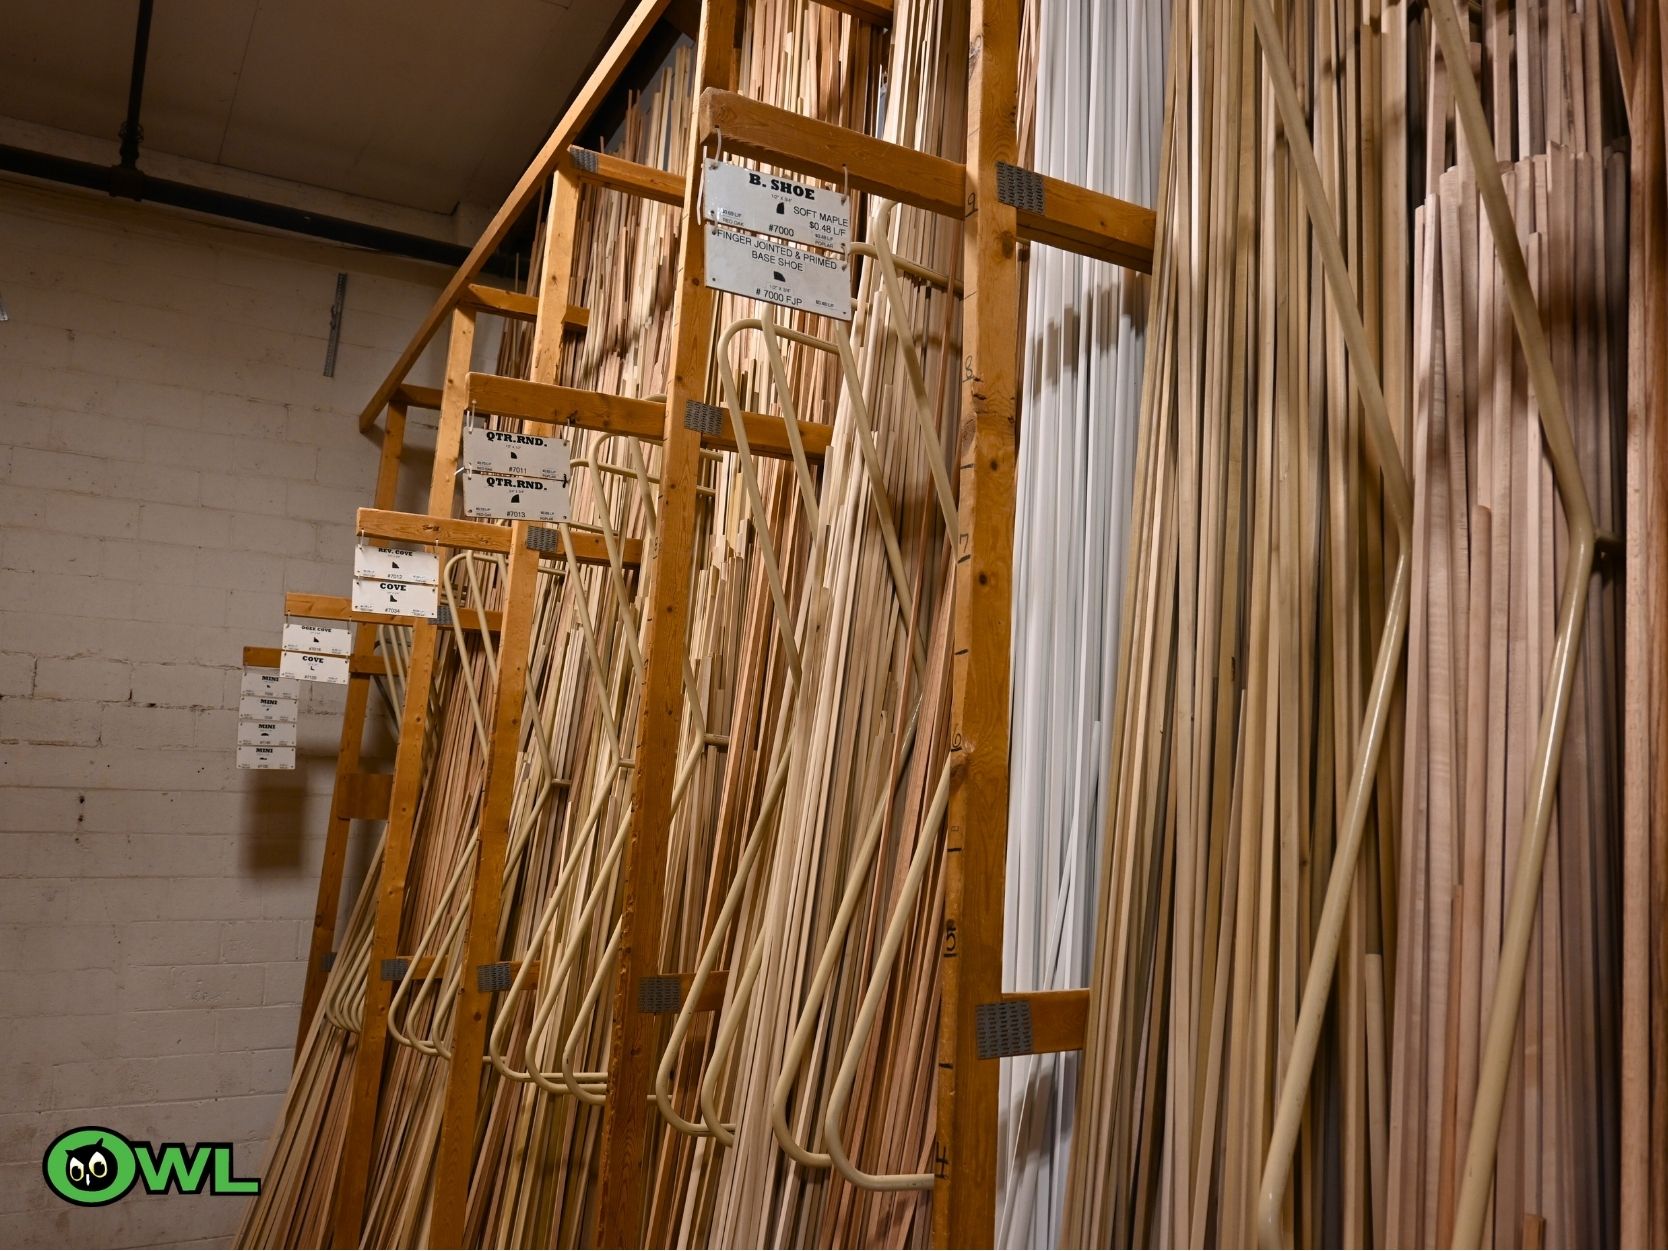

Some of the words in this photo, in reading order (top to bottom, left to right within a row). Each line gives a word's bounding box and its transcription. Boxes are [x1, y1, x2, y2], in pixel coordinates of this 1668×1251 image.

[749, 173, 766, 188] B.
[771, 179, 815, 200] SHOE
[794, 206, 817, 218] SOFT
[820, 213, 848, 227] MAPLE
[768, 224, 795, 237] #7000
[809, 221, 831, 234] $0.48
[833, 227, 846, 237] L/F
[717, 229, 752, 246] FINGER
[754, 240, 793, 257] JOINTED
[795, 251, 801, 259] &
[803, 254, 837, 270] PRIMED
[815, 240, 834, 248] POPLAR
[752, 251, 775, 264] BASE
[778, 258, 803, 272] SHOE
[756, 288, 761, 296] #
[764, 289, 784, 302] 7000
[786, 296, 802, 306] FJP
[486, 432, 547, 447] QTR.RND.
[486, 477, 548, 490] QTR.RND.
[380, 583, 406, 591] COVE
[302, 656, 324, 664] COVE
